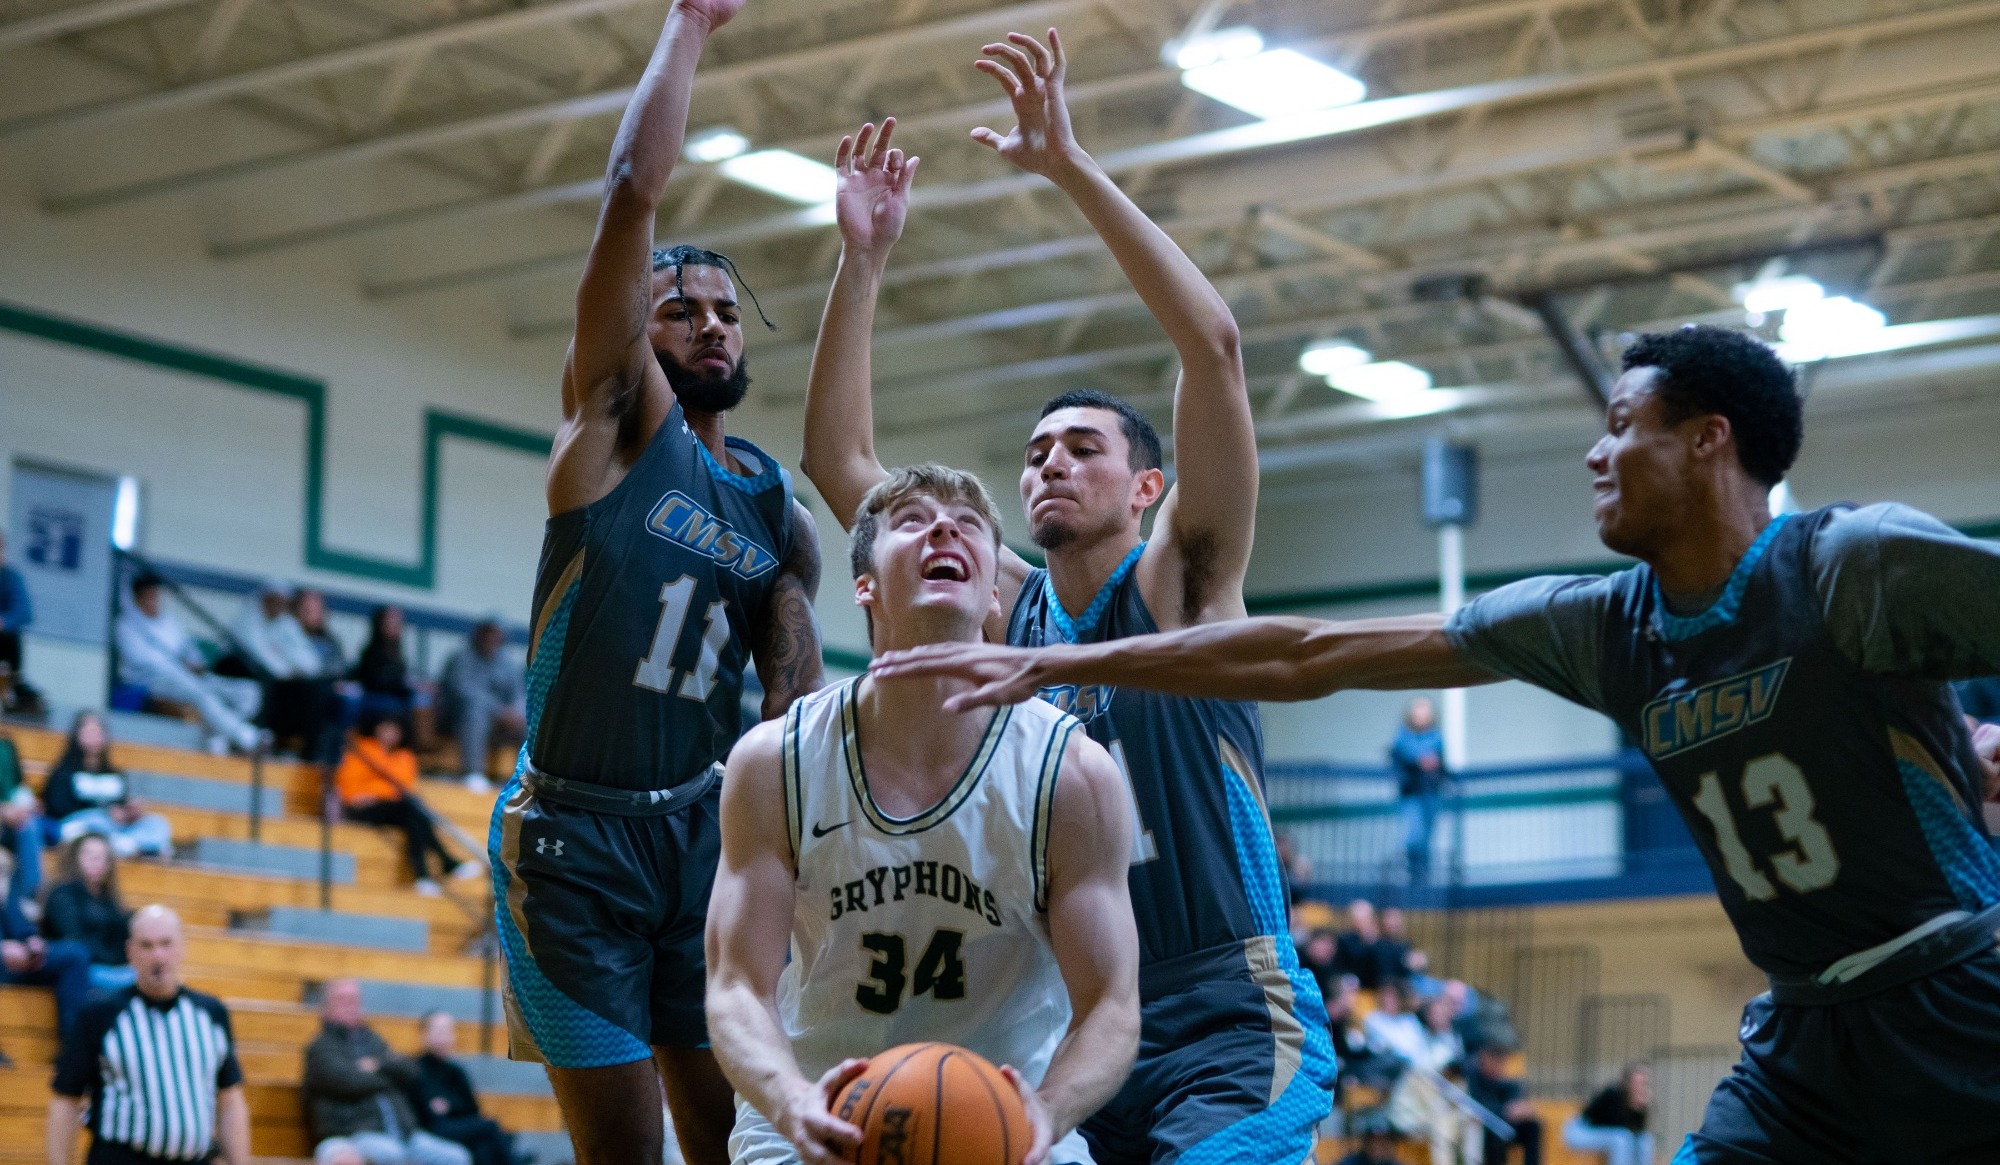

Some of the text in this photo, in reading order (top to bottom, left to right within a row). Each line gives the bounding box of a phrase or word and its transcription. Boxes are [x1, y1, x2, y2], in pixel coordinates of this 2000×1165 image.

[648, 496, 774, 577] CMSV
[632, 573, 729, 702] 11
[1648, 664, 1784, 753] CMSV
[1692, 752, 1841, 901] 13
[830, 861, 1002, 927] GRYPHONS
[856, 926, 967, 1015] 34
